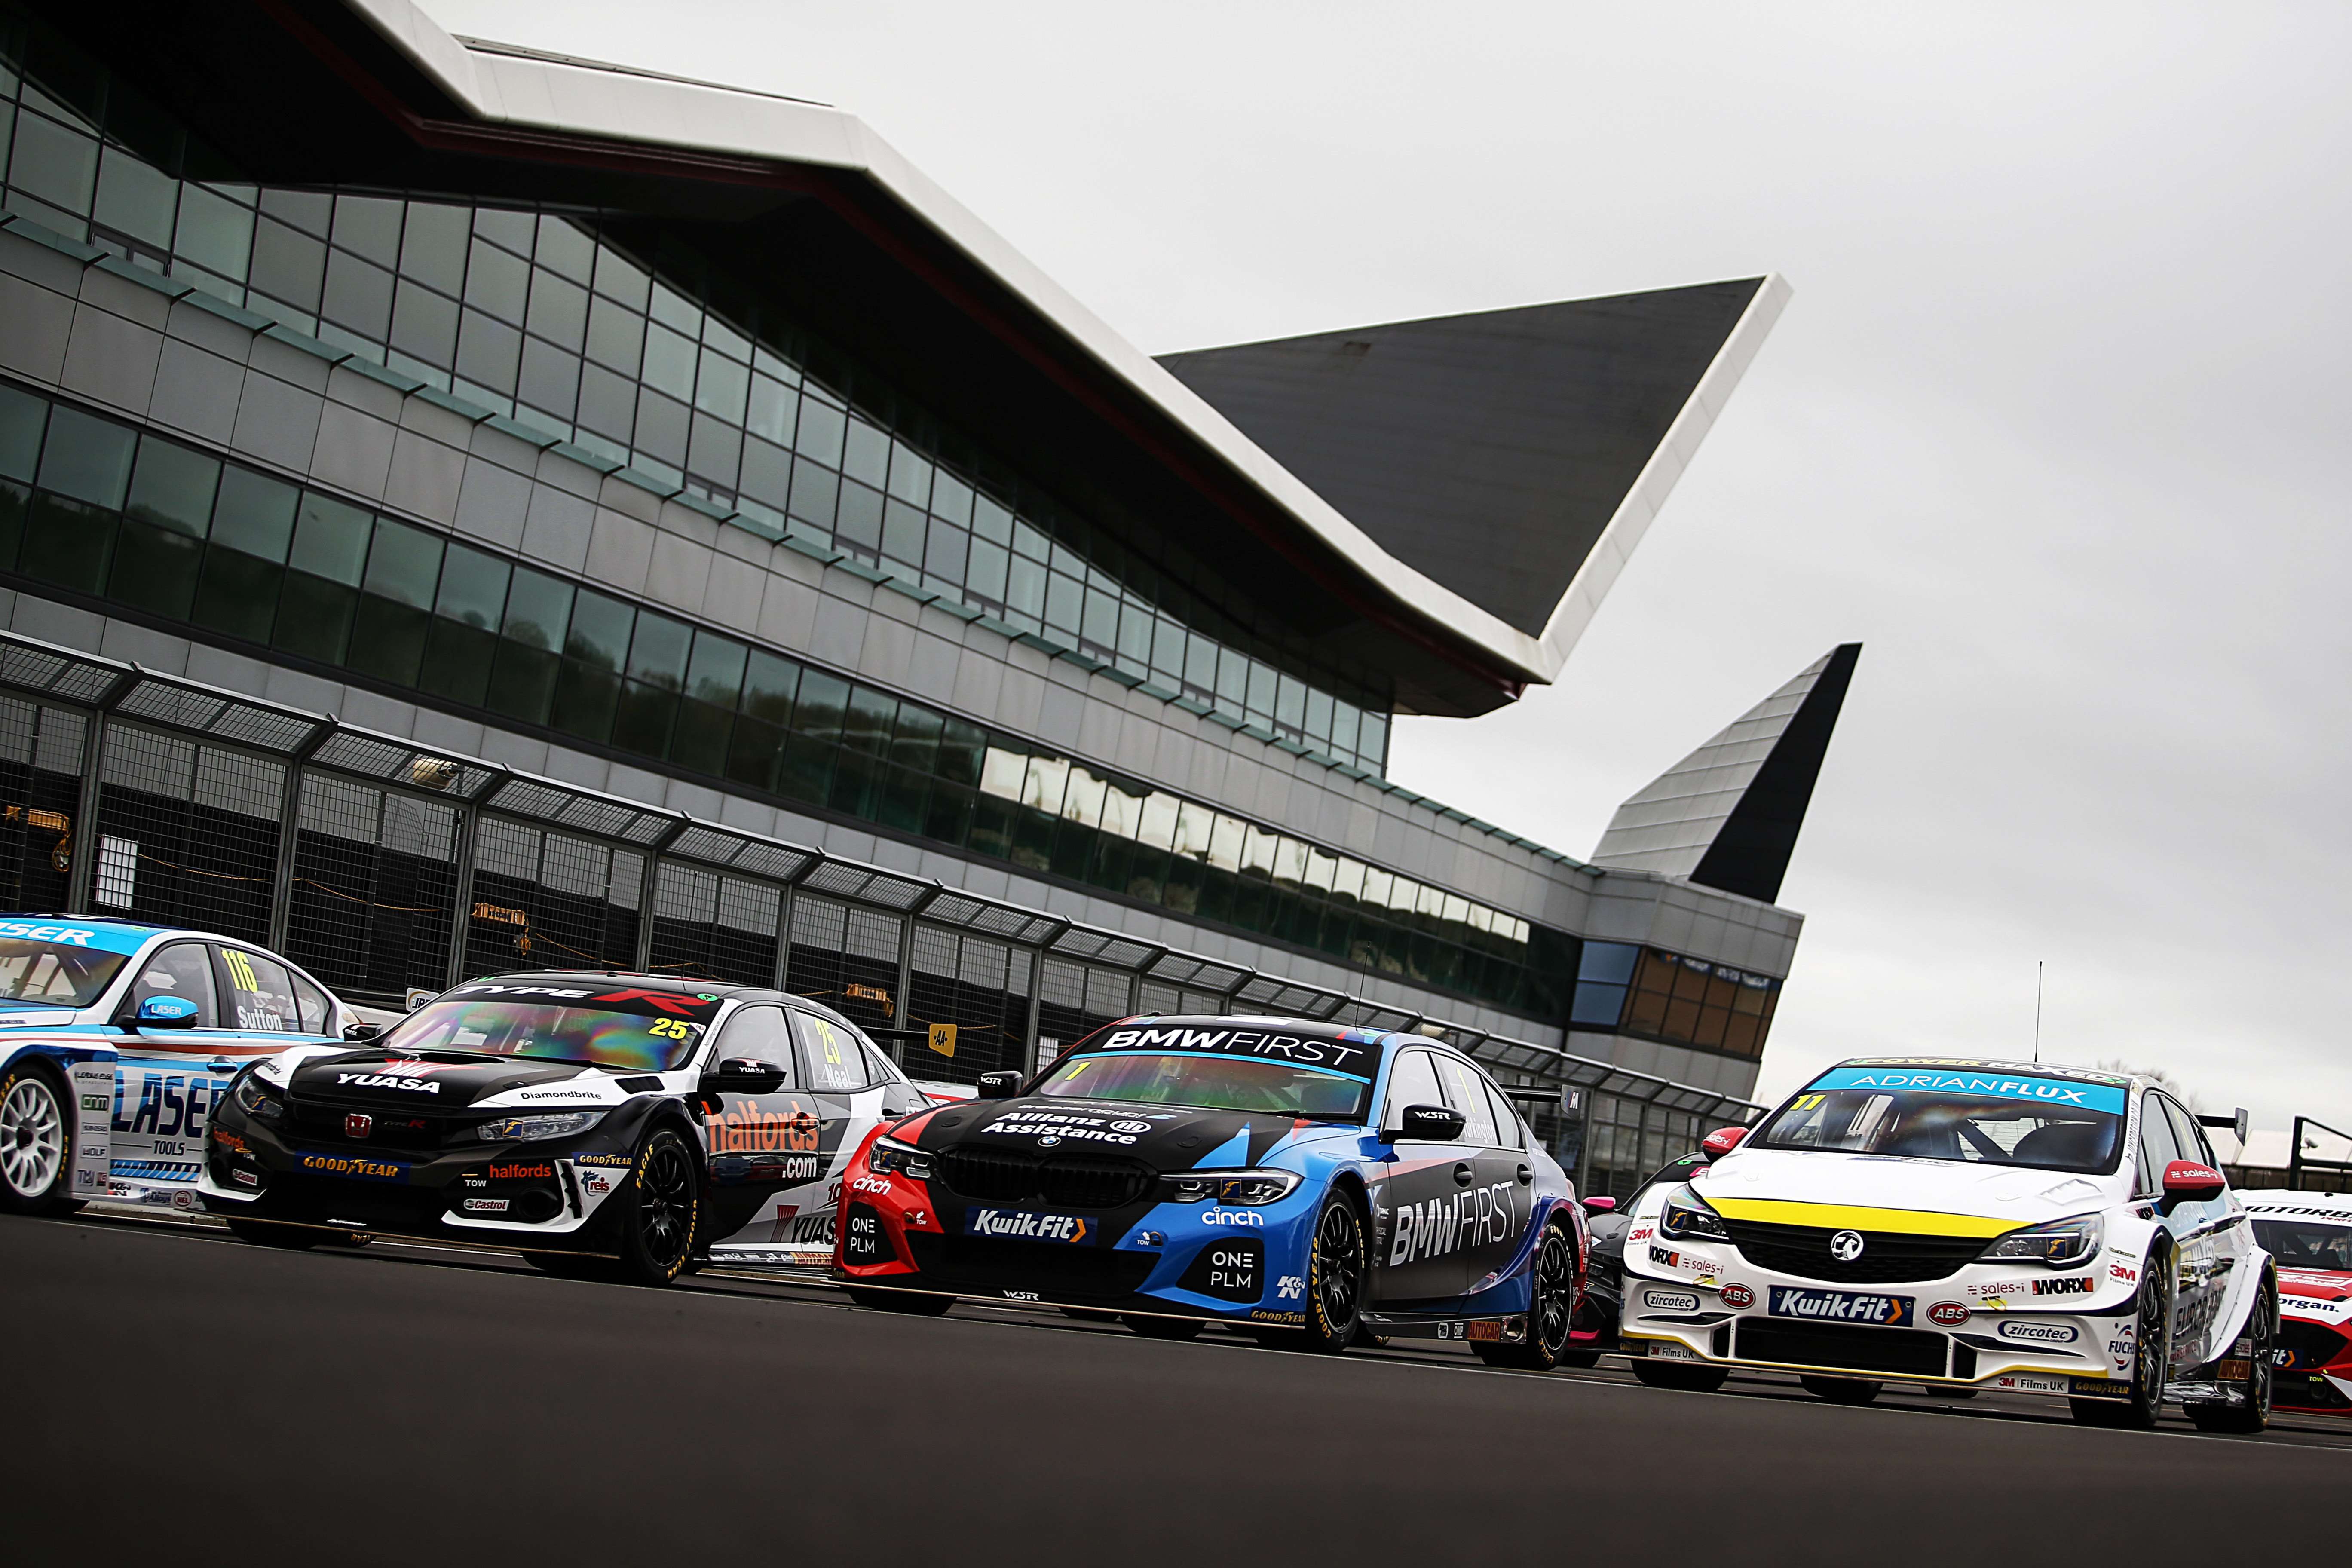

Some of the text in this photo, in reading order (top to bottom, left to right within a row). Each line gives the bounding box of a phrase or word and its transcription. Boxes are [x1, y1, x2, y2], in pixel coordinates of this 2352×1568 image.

[222, 949, 258, 993] 116
[455, 986, 710, 1016] TYPE R
[151, 1004, 182, 1015] LASER
[237, 1004, 283, 1031] Sutton
[648, 1017, 691, 1039] 25
[815, 1019, 841, 1065] 25
[1102, 1029, 1363, 1066] BMWFIRST
[824, 1063, 852, 1088] Neal
[1065, 1061, 1091, 1081] 1
[337, 1073, 440, 1093] YUASA
[980, 1076, 1002, 1085] WSR
[521, 1091, 601, 1099] Diamondbrite
[1850, 1075, 2087, 1103] ADRIANFLUX
[1789, 1094, 1826, 1110] 11
[996, 1112, 1106, 1126] Allianz
[1414, 1111, 1451, 1120] WSR
[701, 1100, 818, 1153] halfords
[981, 1123, 1137, 1144] Assistance
[154, 1140, 185, 1156] TOOLS
[490, 1164, 551, 1178] halfords
[636, 1144, 654, 1190] EAGLE
[782, 1157, 817, 1179] .com
[2183, 1169, 2218, 1179] sales-i
[590, 1177, 610, 1191] reis
[853, 1173, 892, 1195] cinch
[474, 1200, 506, 1210] Castrol
[2245, 1206, 2352, 1219] OTORB
[1201, 1206, 1264, 1226] cinch
[1390, 1180, 1516, 1267] BMWFIRST
[790, 1216, 836, 1245] YUAS
[852, 1217, 875, 1233] ONE
[1628, 1228, 1653, 1240] 3M
[850, 1237, 875, 1253] PLM
[1212, 1251, 1254, 1268] ONE
[1691, 1259, 1724, 1275] sales-i
[1210, 1271, 1251, 1288] PLM
[2109, 1264, 2136, 1282] 3M
[2110, 1277, 2125, 1285] Films
[1277, 1276, 1305, 1299] K&N
[1981, 1282, 2024, 1294] sales-i
[2036, 1278, 2087, 1295] WORX
[1003, 1290, 1039, 1301] WSR
[1650, 1294, 1692, 1308] zircotec
[1724, 1289, 1750, 1302] ABS
[1934, 1308, 1966, 1319] ABS
[1469, 1321, 1499, 1340] AUTOCAR
[2008, 1324, 2069, 1340] zircotec
[1650, 1346, 1694, 1359] 3M Films UK
[1999, 1377, 2064, 1391] 3M Films UK
